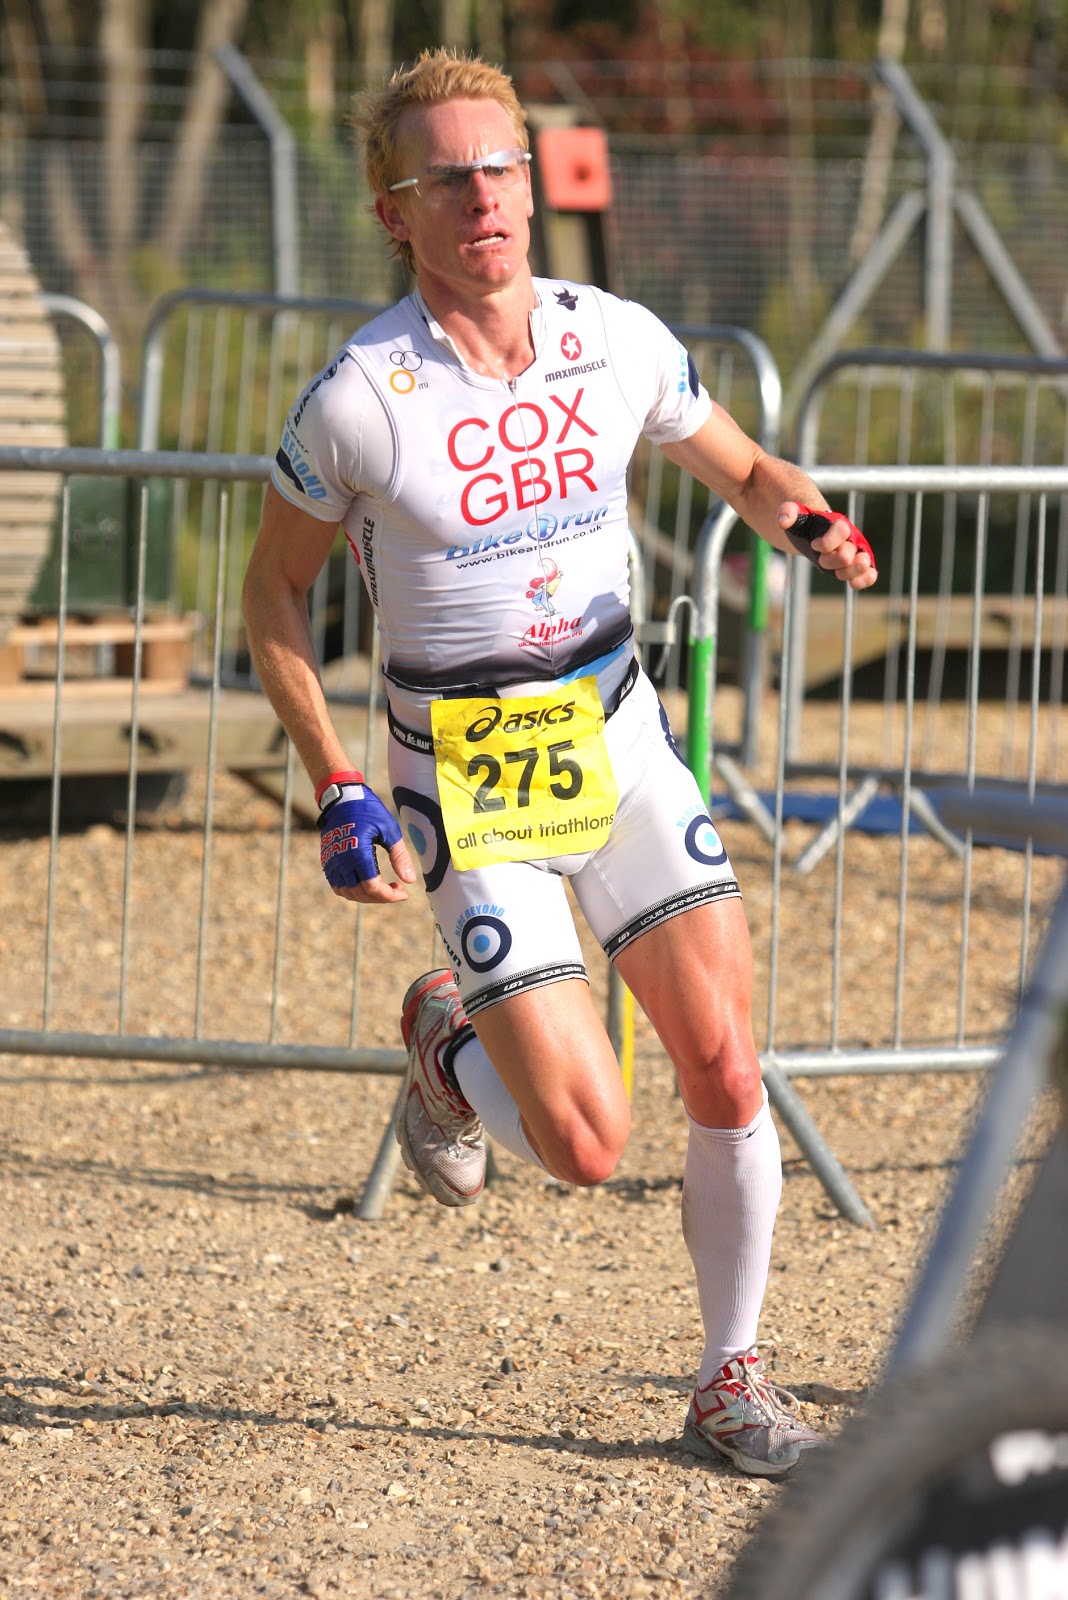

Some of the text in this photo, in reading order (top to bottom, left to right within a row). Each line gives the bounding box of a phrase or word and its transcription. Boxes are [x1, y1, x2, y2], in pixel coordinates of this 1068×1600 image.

[418, 382, 429, 390] ITU
[545, 359, 607, 383] MAXIMUSCLE
[447, 387, 599, 472] COX
[282, 430, 327, 499] BEYOND
[460, 447, 599, 527] GBR
[445, 504, 609, 561] bike run
[456, 524, 603, 569] www.bikeandrun.co.uk
[362, 516, 379, 608] MAXIMUSCLE
[521, 616, 582, 641] Alpha
[503, 700, 576, 733] asics
[467, 739, 584, 814] 275
[456, 813, 615, 849] all about triathlons
[464, 904, 506, 918] BEYOND
